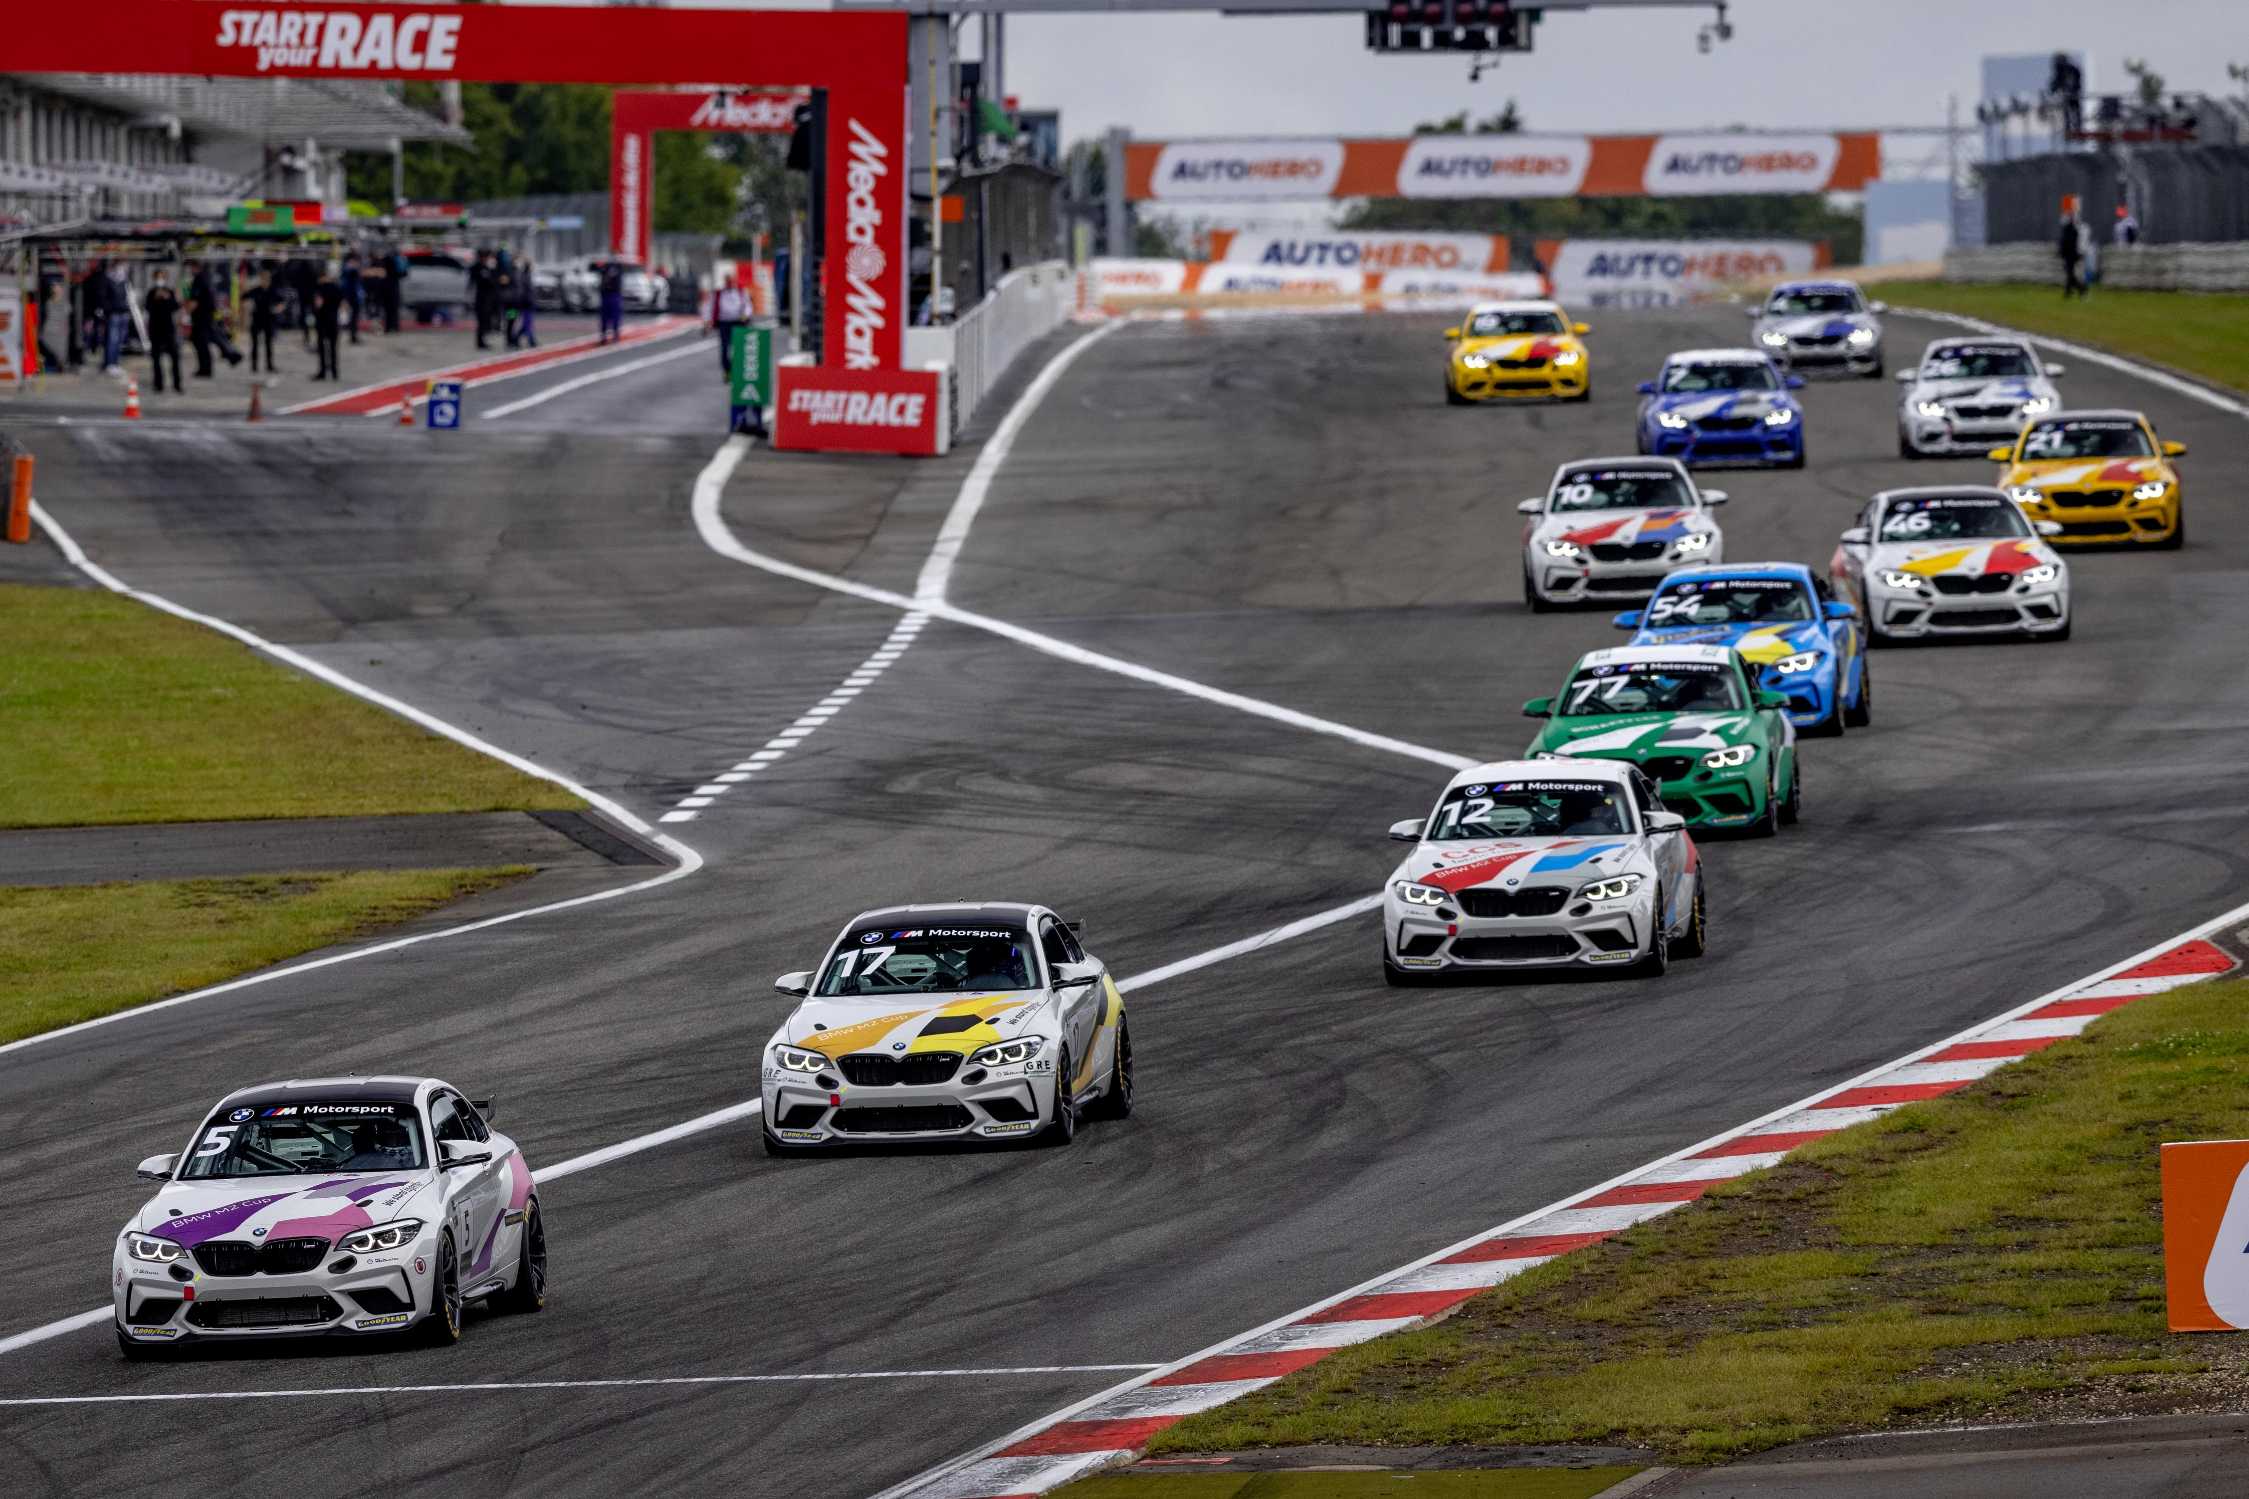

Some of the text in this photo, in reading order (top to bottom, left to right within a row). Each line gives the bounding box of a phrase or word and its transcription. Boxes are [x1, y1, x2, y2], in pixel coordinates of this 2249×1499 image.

[216, 10, 325, 47] START
[318, 11, 462, 70] RACE
[256, 46, 319, 71] your
[1172, 158, 1324, 181] AUTOHERO
[1418, 156, 1571, 178] AUTOHERO
[1665, 153, 1818, 175] AUTOHERO
[1262, 240, 1460, 268] AUTOHERO
[1587, 249, 1786, 278] AUTOHERO
[845, 273, 885, 369] Mark
[788, 388, 849, 411] START
[846, 391, 926, 427] RACE
[1557, 483, 1594, 505] 10
[1883, 511, 1931, 533] 46
[1650, 594, 1704, 619] 54
[1650, 663, 1720, 673] Motorsport
[1572, 674, 1631, 705] 77
[1528, 781, 1604, 792] Motorsport
[1442, 797, 1495, 826] 12
[929, 928, 1012, 939] Motorsport
[837, 945, 896, 978] 17
[817, 1027, 854, 1041] BMW
[303, 1104, 395, 1114] Motorsport
[195, 1125, 240, 1158] 5
[171, 1197, 272, 1228] BMW M2 Cup
[358, 1314, 407, 1327] GOODYEAR
